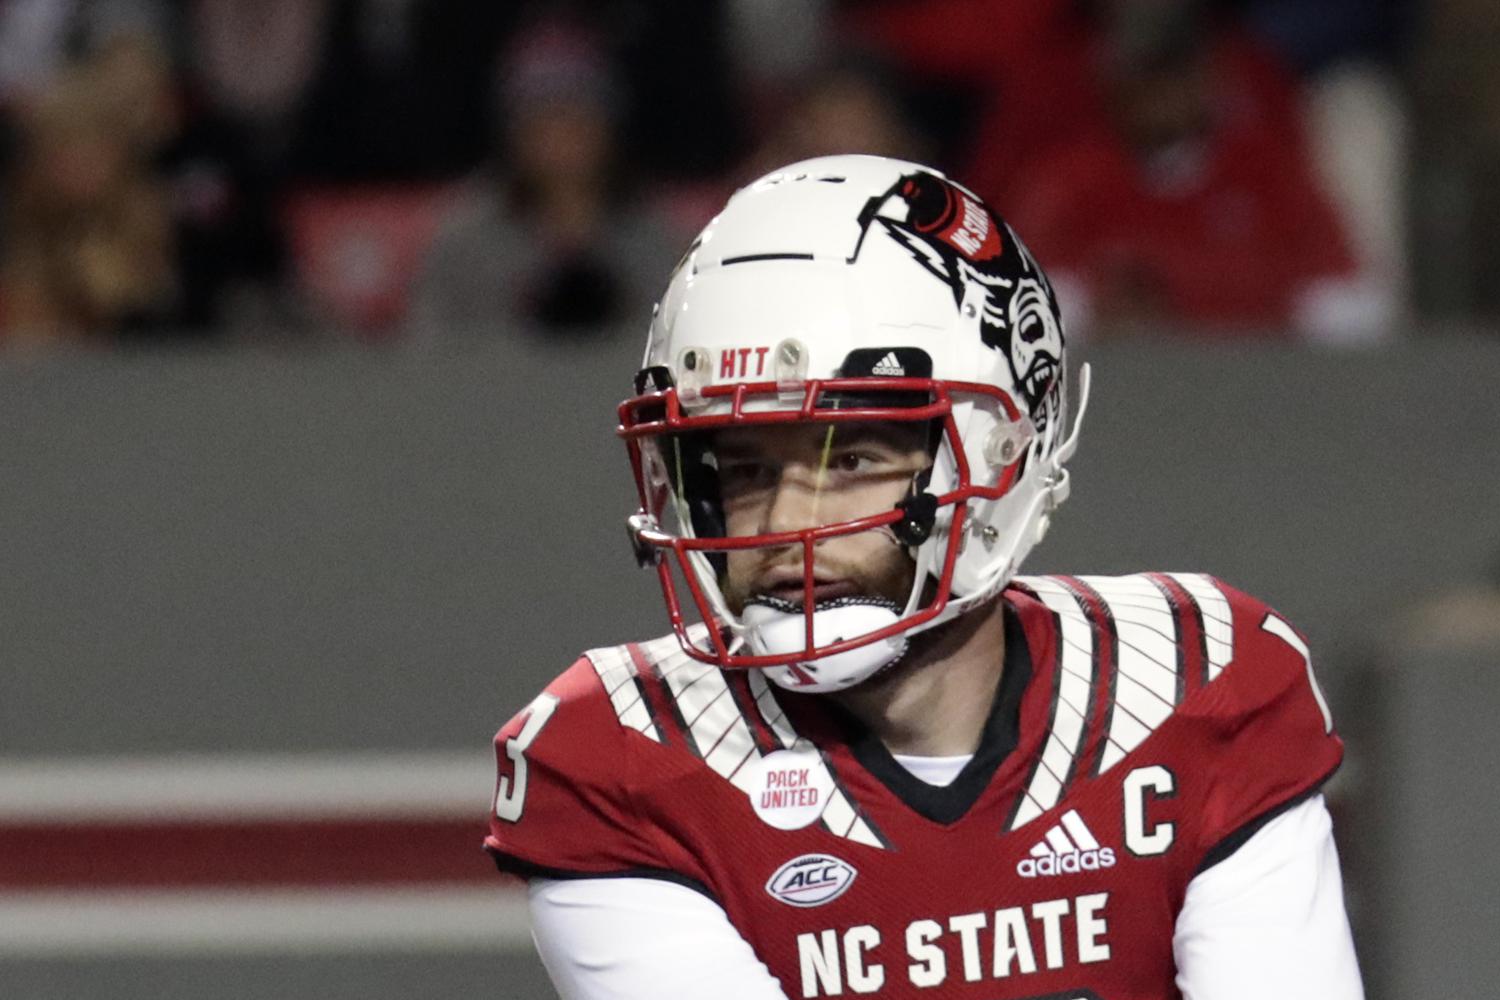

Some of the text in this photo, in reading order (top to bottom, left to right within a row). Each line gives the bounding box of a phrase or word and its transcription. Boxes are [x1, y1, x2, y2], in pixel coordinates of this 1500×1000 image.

[720, 347, 770, 379] HTT
[872, 365, 906, 376] adidas
[495, 691, 561, 824] 3
[766, 769, 810, 788] PACK
[761, 788, 818, 809] UNITED
[1122, 764, 1175, 857] C
[781, 865, 838, 891] ACC
[1016, 846, 1117, 878] adidas
[796, 891, 1111, 999] NC STATE
